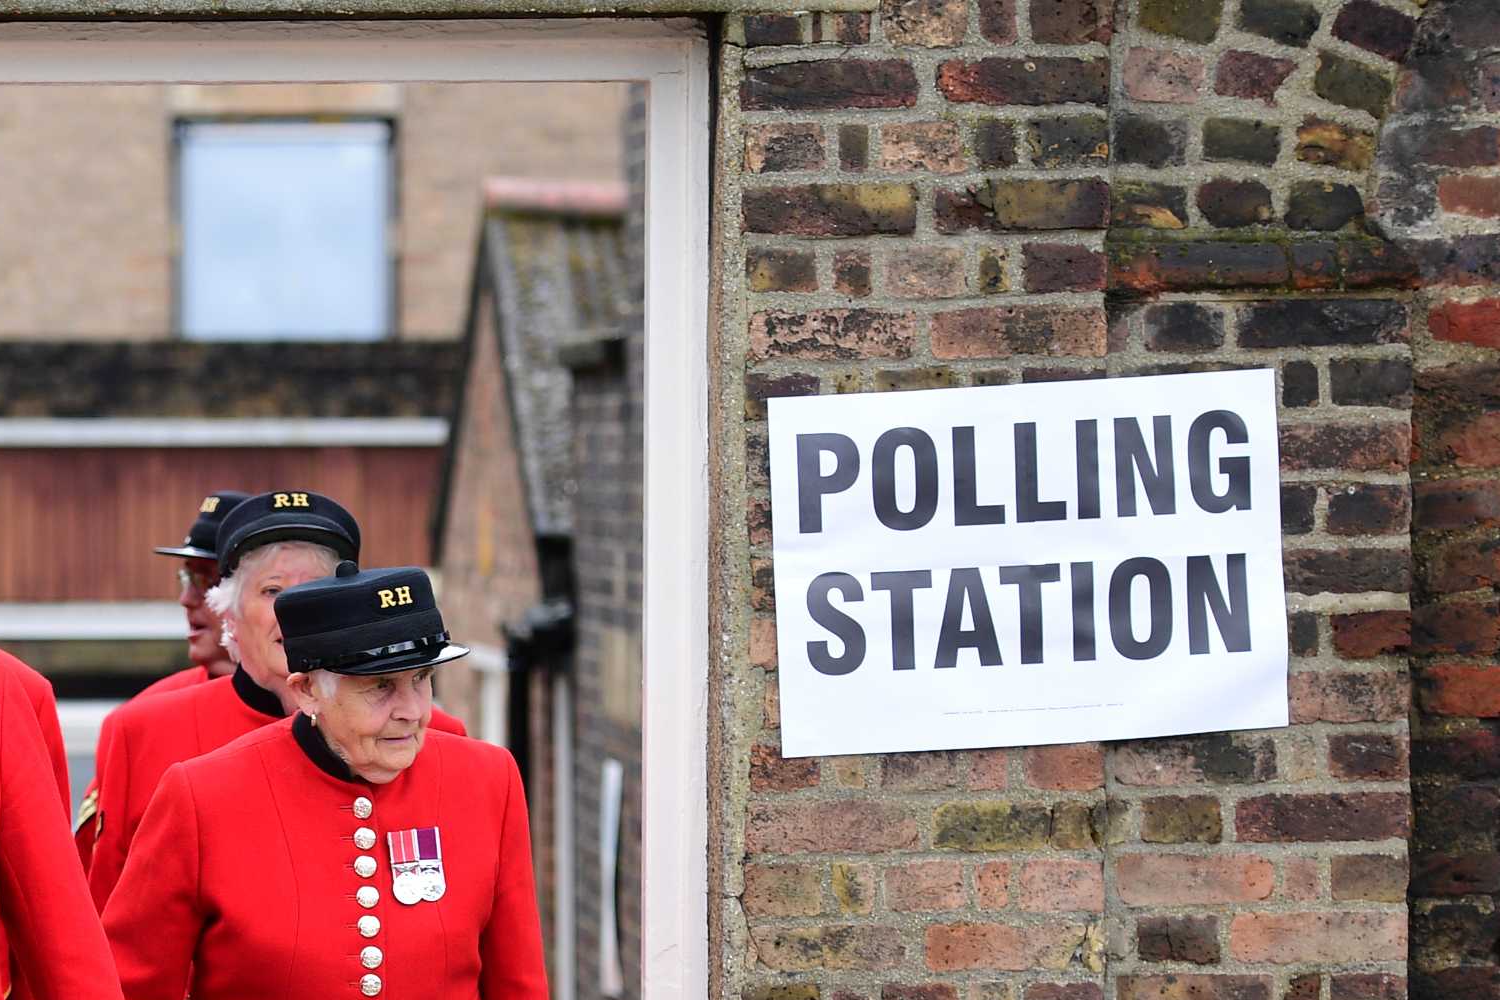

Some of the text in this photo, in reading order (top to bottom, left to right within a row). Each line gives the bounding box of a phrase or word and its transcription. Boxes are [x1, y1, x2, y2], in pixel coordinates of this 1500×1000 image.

[273, 492, 310, 508] RH
[796, 409, 1252, 534] POLLING
[377, 585, 414, 609] RH
[806, 552, 1252, 676] STATION
